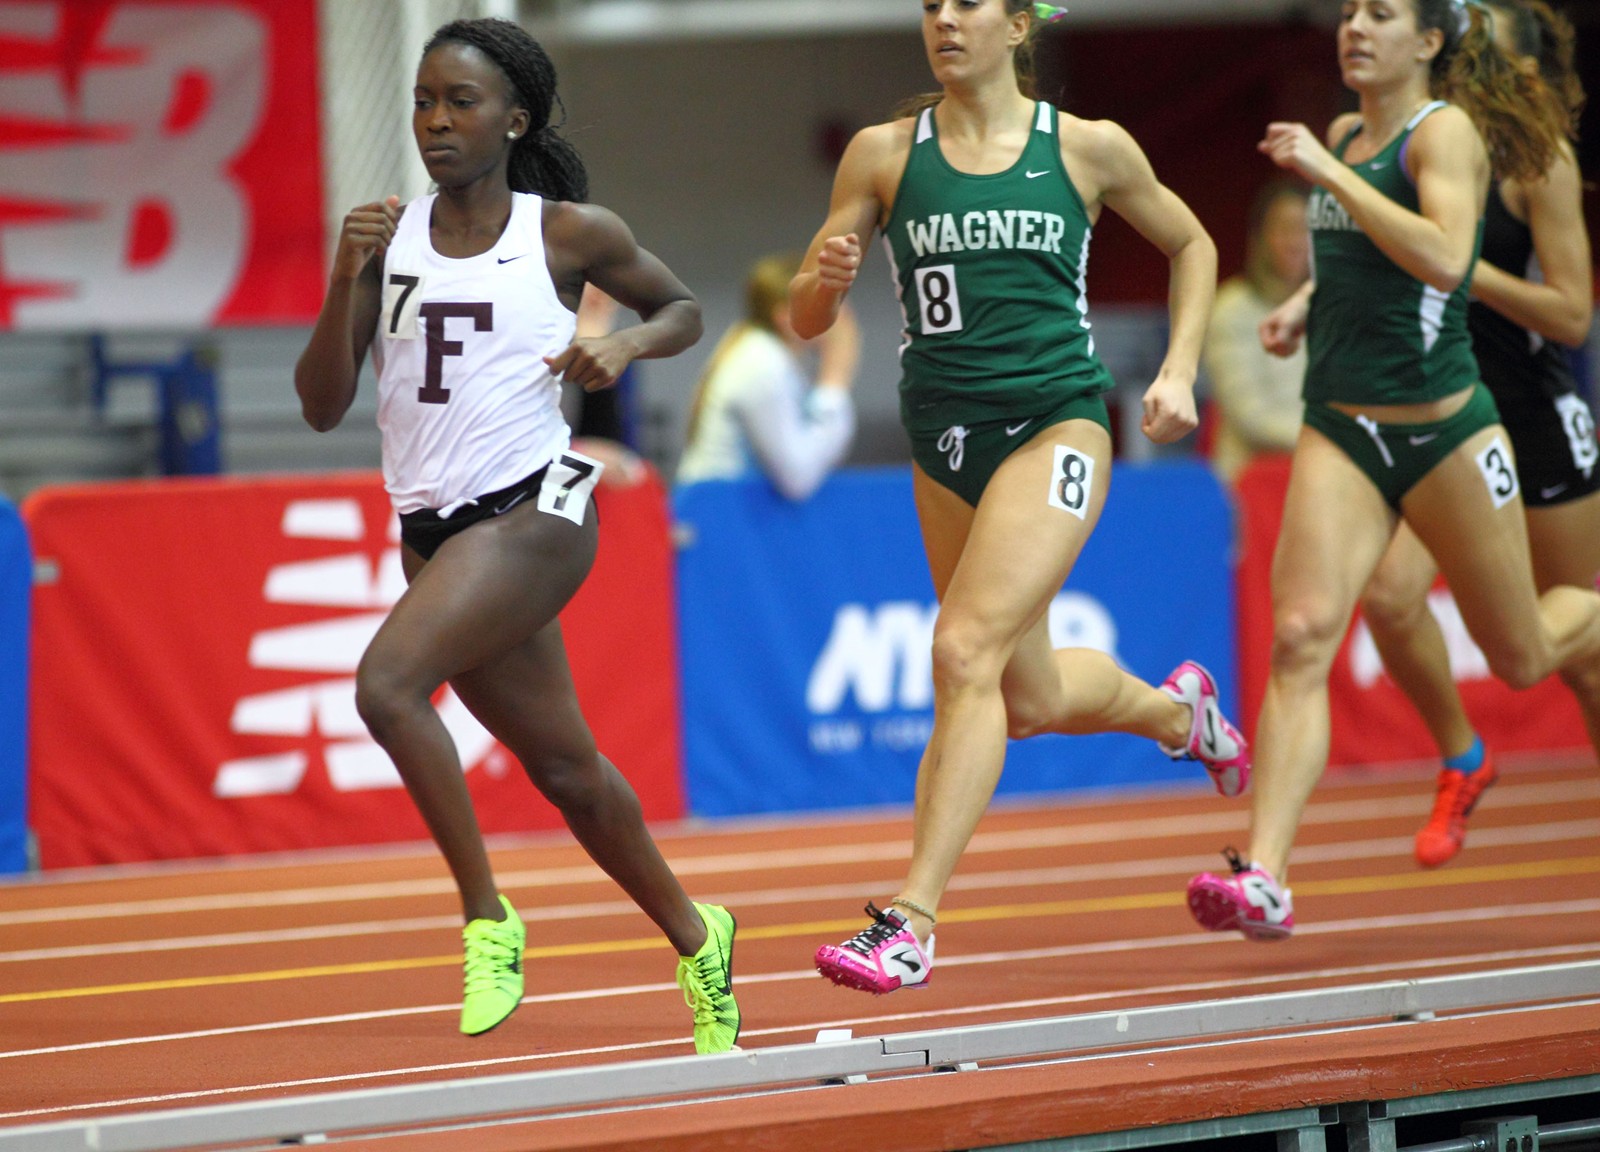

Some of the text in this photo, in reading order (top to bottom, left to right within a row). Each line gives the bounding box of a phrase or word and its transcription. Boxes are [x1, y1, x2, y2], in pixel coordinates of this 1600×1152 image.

[906, 209, 1066, 257] WAGNER
[389, 273, 420, 334] 7
[922, 270, 953, 328] 8
[417, 301, 494, 405] F
[552, 453, 596, 512] 7
[1057, 452, 1087, 511] 8
[1485, 447, 1514, 497] 3
